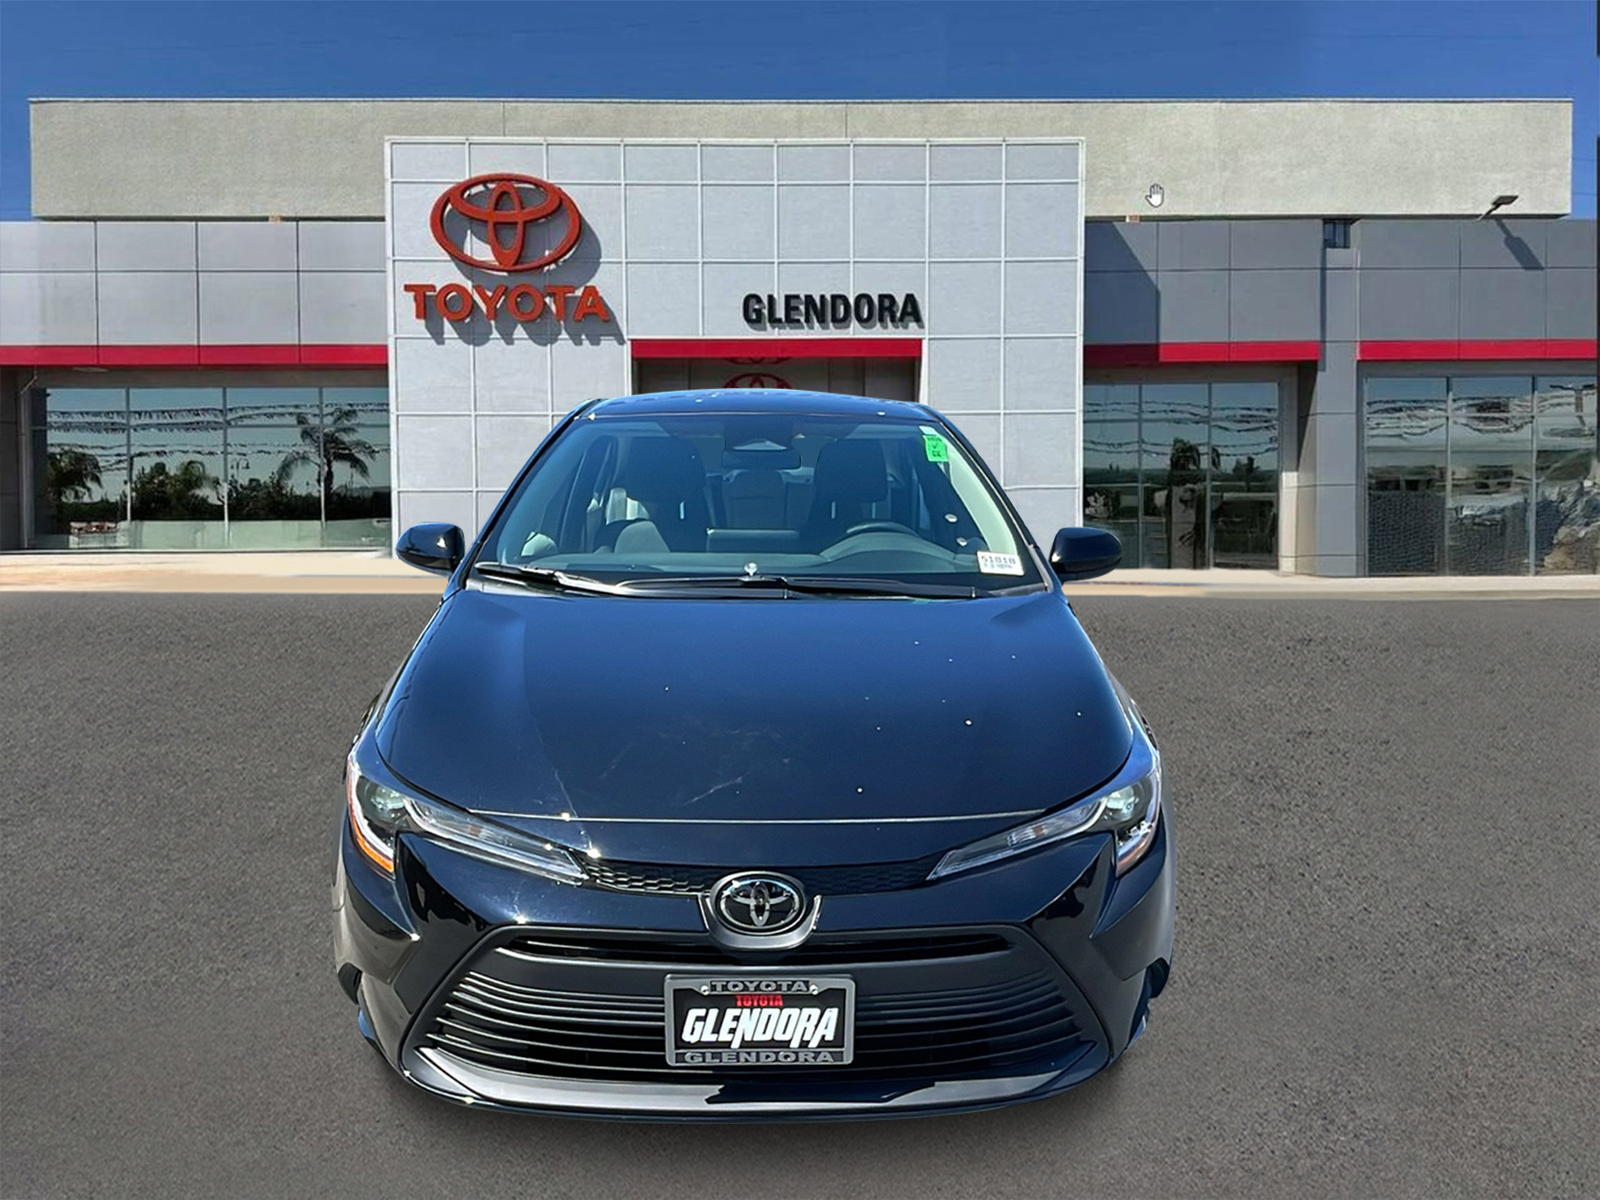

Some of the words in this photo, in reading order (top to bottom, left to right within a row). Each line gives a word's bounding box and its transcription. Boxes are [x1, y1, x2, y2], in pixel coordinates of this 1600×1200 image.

[404, 283, 609, 321] TOYOTA
[742, 294, 922, 324] GLENDORA
[711, 981, 808, 992] TOYOTA
[735, 995, 783, 1007] TOYOTA
[681, 1008, 839, 1049] GLENDORA
[684, 1051, 834, 1063] GLENDORA
